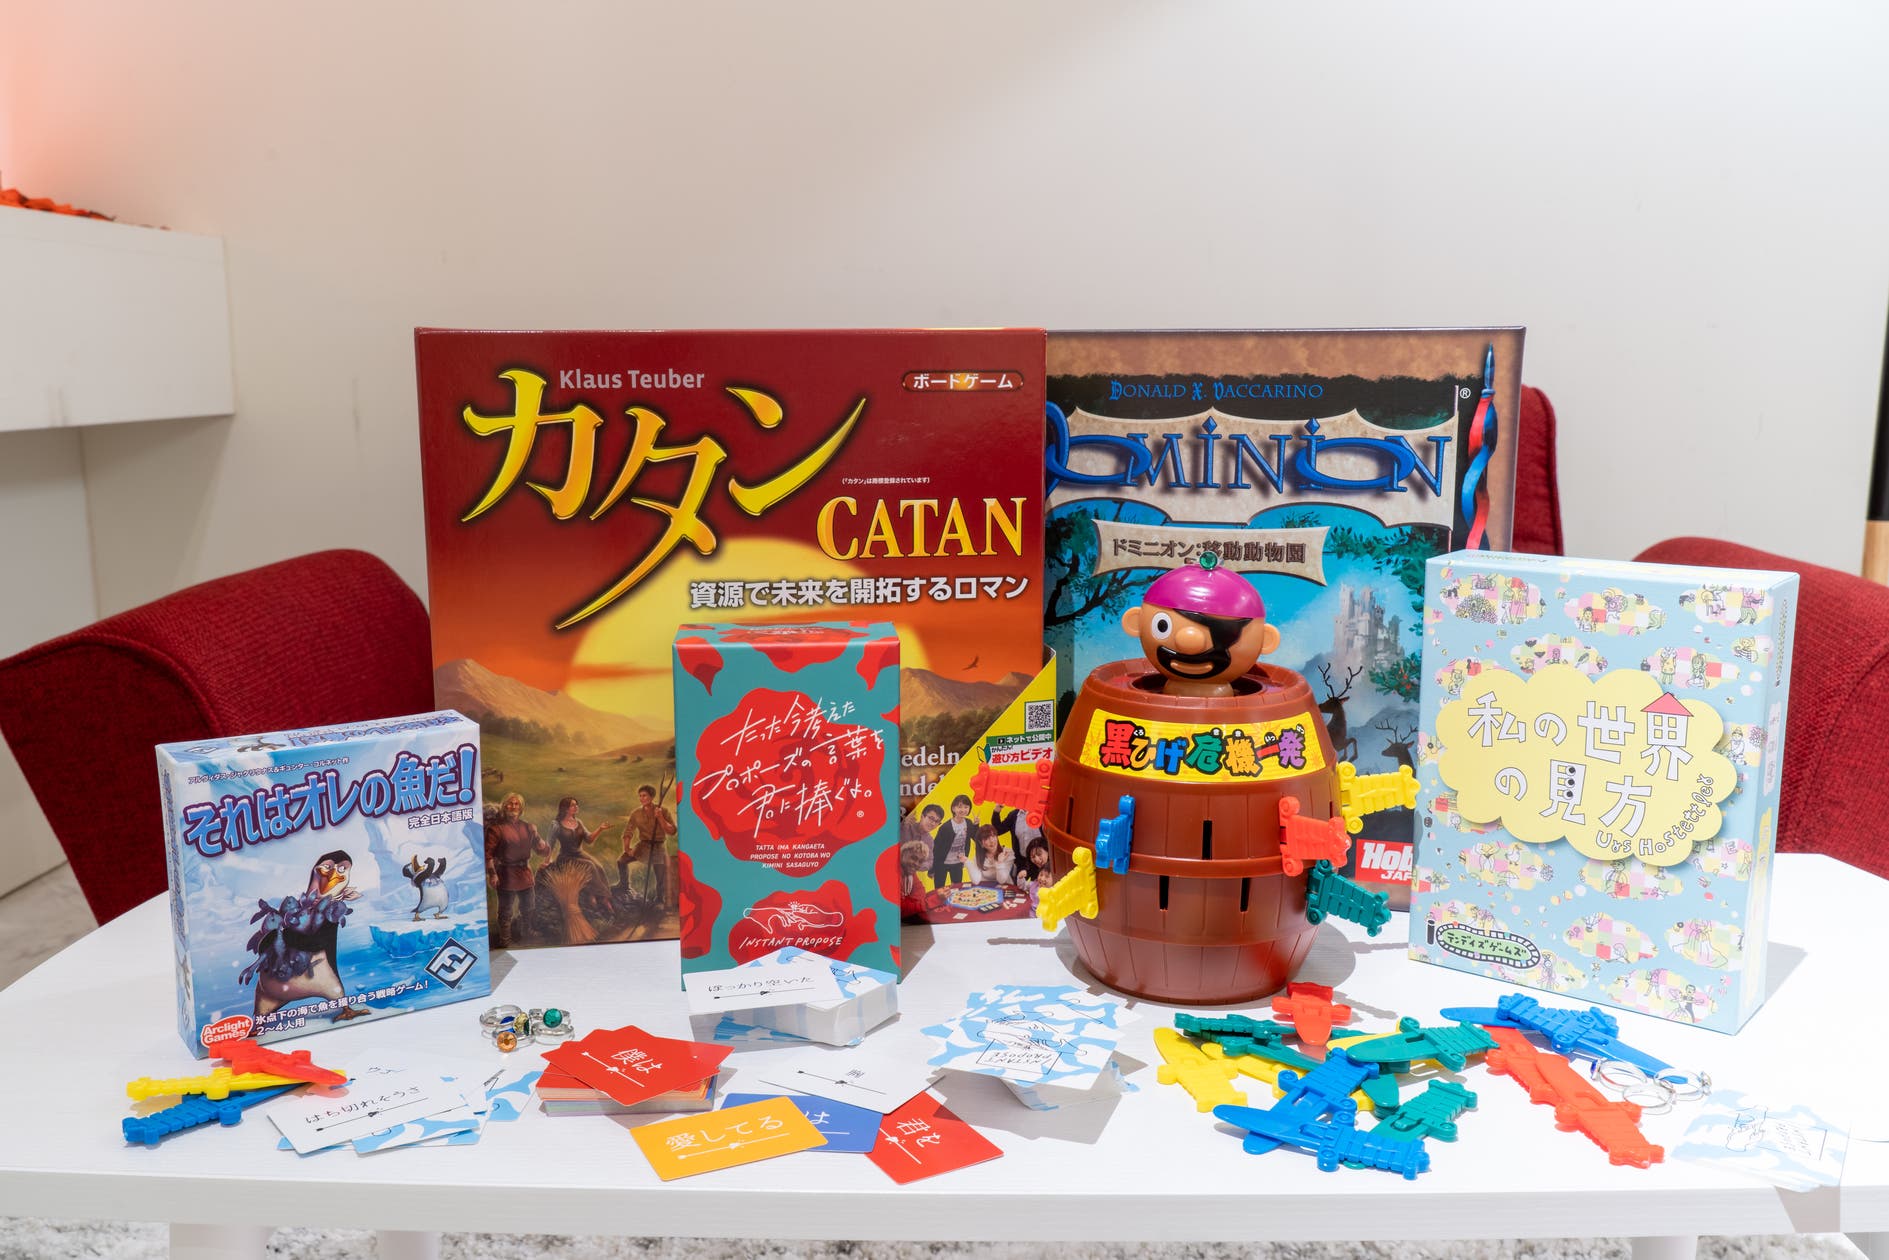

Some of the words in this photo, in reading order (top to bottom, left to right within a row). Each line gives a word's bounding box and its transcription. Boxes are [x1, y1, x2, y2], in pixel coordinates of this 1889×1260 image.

[559, 369, 622, 389] Klaus
[628, 369, 705, 389] Teuber
[913, 373, 1013, 389] ボードゲーム
[1109, 380, 1186, 400] DONALD
[1213, 381, 1324, 400] VACCARINO
[462, 368, 866, 628] カタン
[816, 496, 1027, 560] CATAN
[690, 575, 1029, 609] 資源で未来を開拓するロマン
[720, 695, 855, 756] たった今考えた
[1467, 691, 1694, 780] 私の世界
[694, 725, 884, 800] プロポーズの言葉を
[992, 747, 1053, 764] 遊び方ビデオ
[1100, 719, 1306, 776] 黒ひげ危機一発
[1495, 759, 1652, 838] の見方
[408, 809, 473, 829] 完全日本語版
[738, 935, 794, 950] INSTANT
[795, 935, 843, 948] PROPOSE
[203, 1018, 251, 1036] Arclight
[203, 1029, 246, 1044] Games
[666, 1115, 784, 1152] 愛してる
[896, 1118, 941, 1147] 君を
